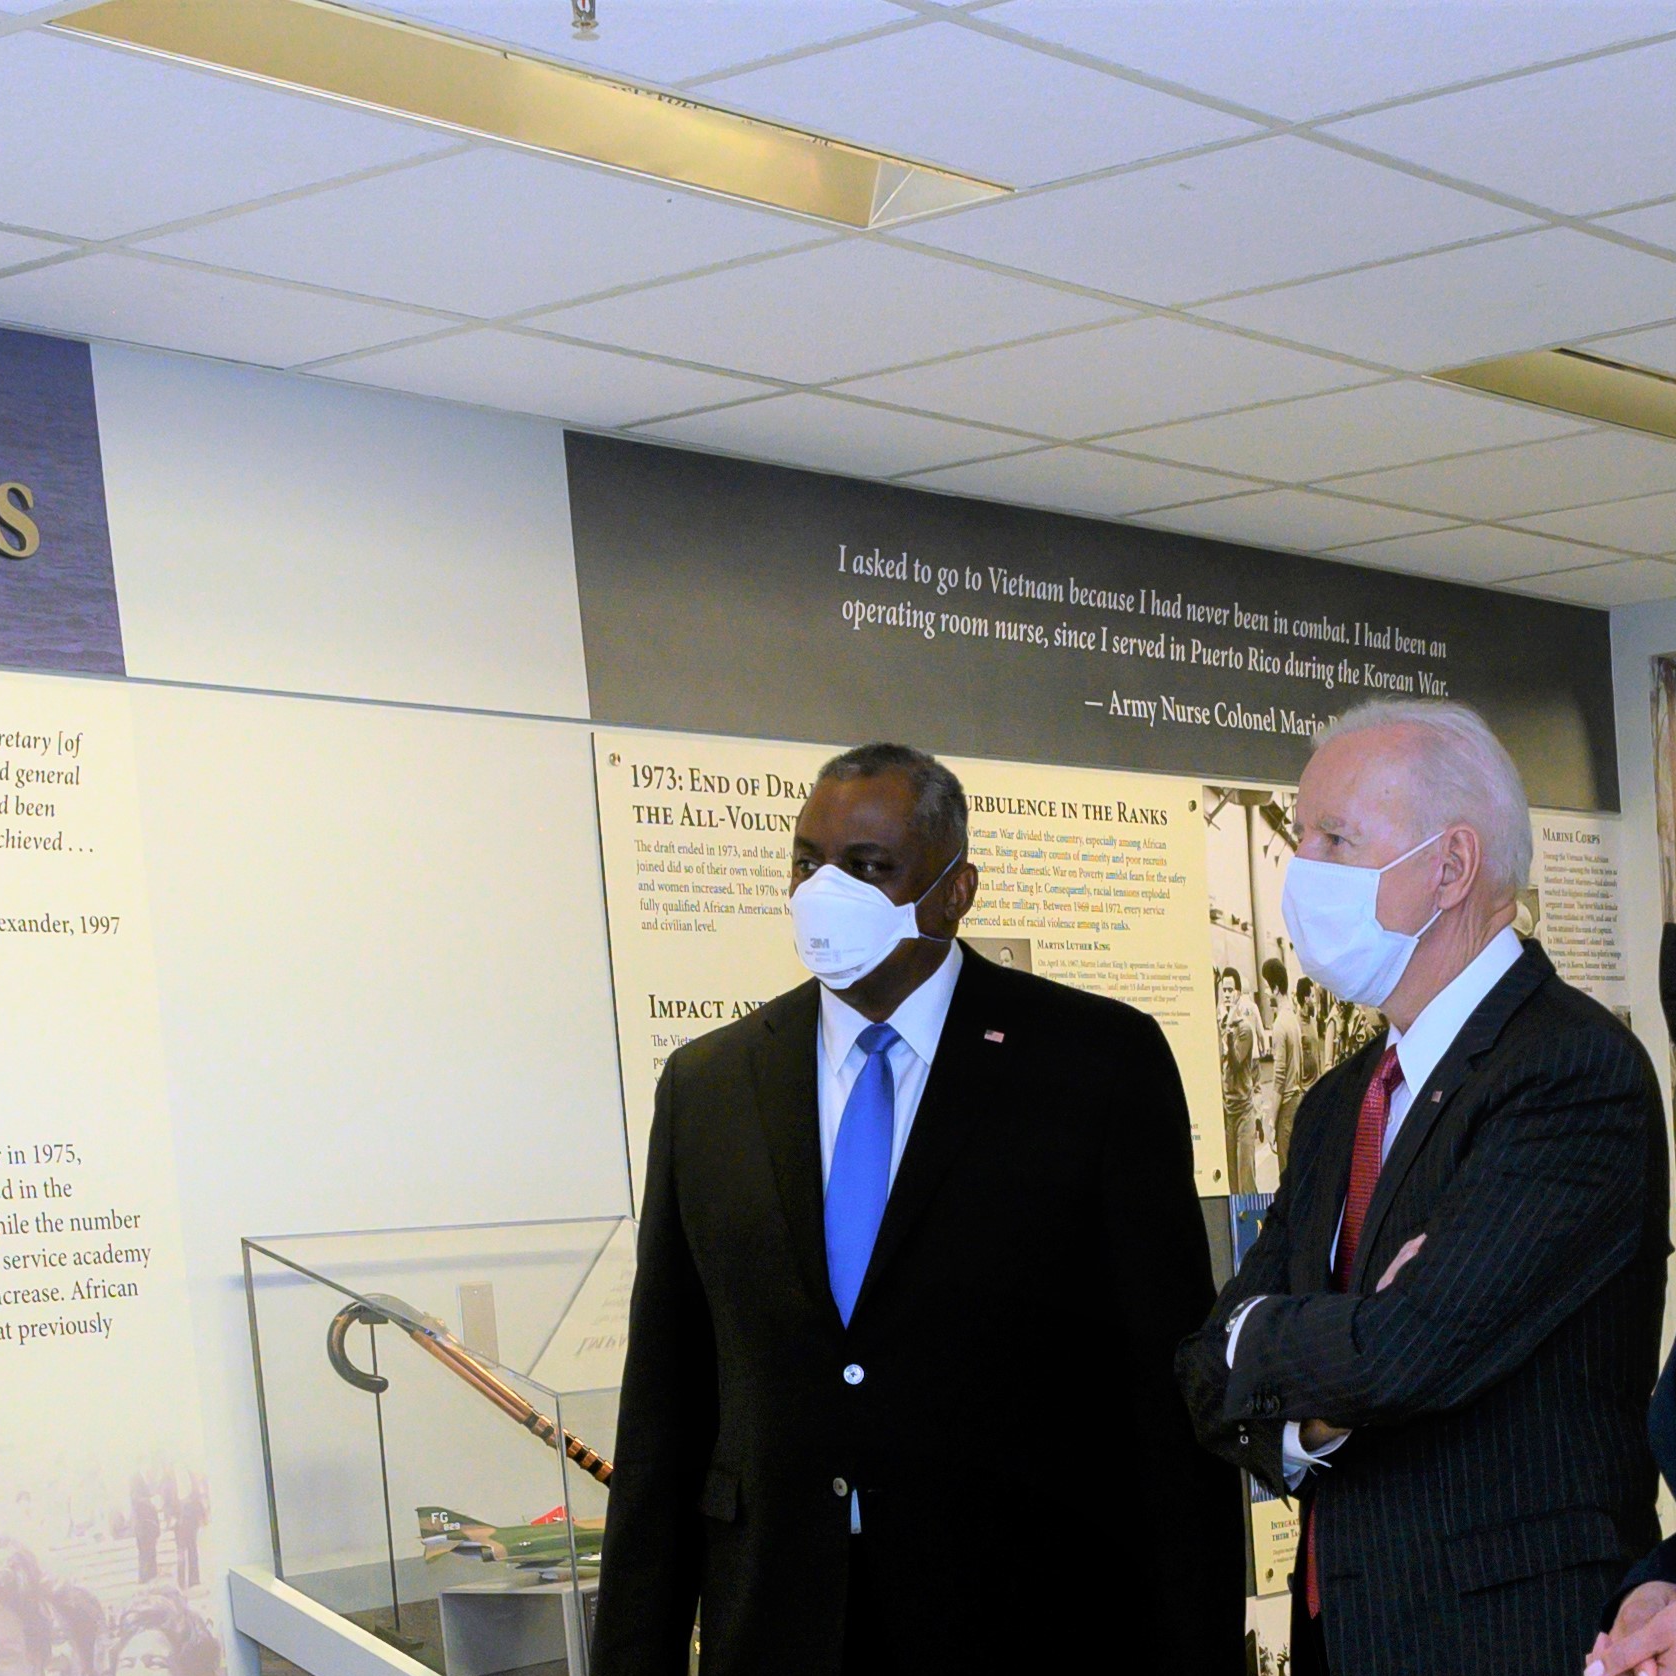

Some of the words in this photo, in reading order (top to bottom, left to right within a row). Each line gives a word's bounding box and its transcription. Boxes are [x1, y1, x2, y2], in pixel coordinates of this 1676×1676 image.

[838, 544, 846, 572] I
[852, 548, 907, 581] asked
[913, 558, 932, 584] to
[936, 566, 958, 592] go
[965, 565, 982, 591] to
[987, 566, 1064, 603] Vietnam
[1069, 576, 1134, 613] because
[1139, 589, 1146, 614] I
[1151, 589, 1182, 619] had
[1186, 603, 1230, 626] never
[1234, 601, 1269, 632] been
[1273, 609, 1288, 635] in
[1292, 615, 1349, 644] combat.
[1354, 622, 1360, 646] I
[1364, 622, 1391, 650] had
[1394, 627, 1426, 656] been
[1429, 640, 1446, 658] an
[842, 599, 936, 639] operating
[940, 612, 989, 637] room
[994, 620, 1048, 649] nurse,
[1053, 621, 1095, 651] since
[1100, 626, 1107, 652] I
[1112, 632, 1165, 659] served
[1169, 635, 1186, 662] in
[1190, 638, 1243, 670] Puerto
[1247, 646, 1280, 674] Rico
[1284, 651, 1334, 689] during
[1337, 658, 1359, 685] the
[1363, 663, 1414, 693] Korean
[1418, 671, 1449, 697] War.
[1108, 689, 1157, 727] Army
[1160, 695, 1210, 725] Nurse
[1214, 701, 1276, 732] Colonel
[57, 730, 83, 759] [of
[631, 764, 683, 791] 1973:
[688, 767, 730, 794] END
[736, 777, 759, 796] OF
[632, 804, 673, 825] THE
[1061, 801, 1077, 819] IN
[1082, 803, 1112, 821] THE
[1117, 801, 1167, 826] RANKS
[80, 915, 120, 934] 1997
[810, 938, 830, 949] 3M
[648, 994, 724, 1019] IMPACT
[7, 1144, 26, 1164] in
[33, 1143, 81, 1165] 1975,
